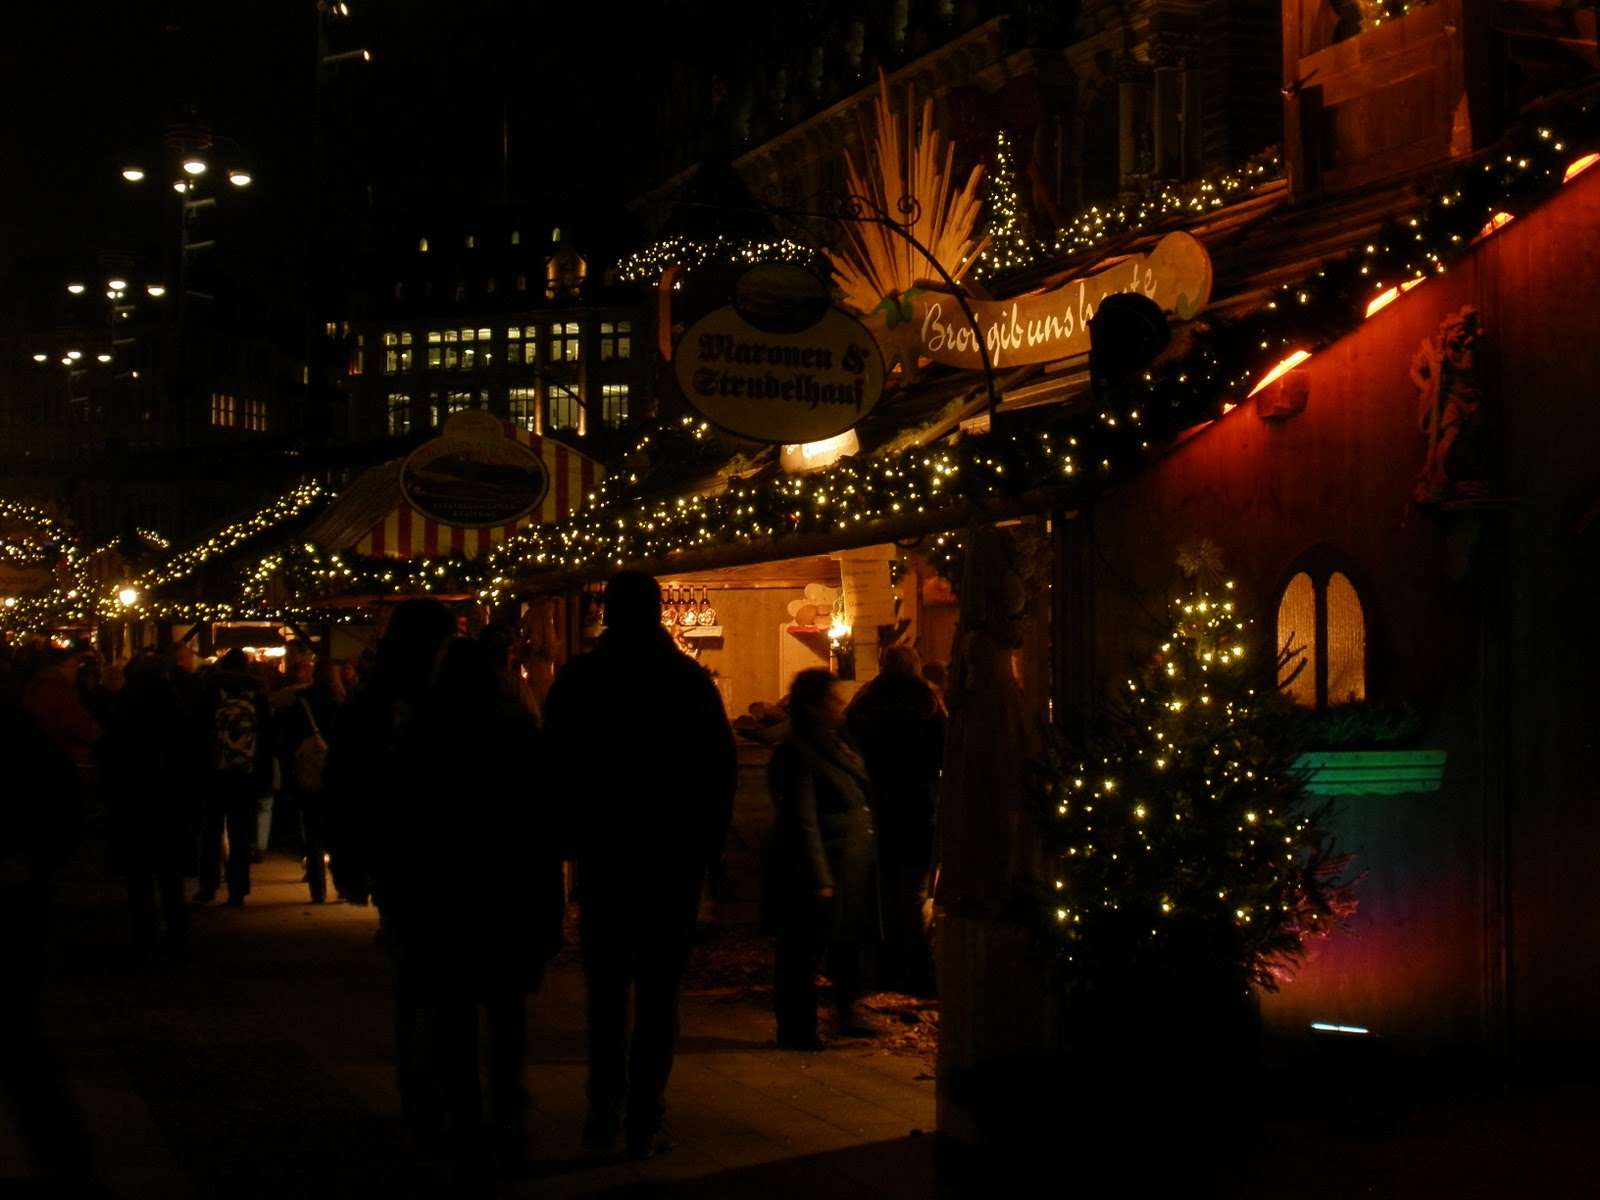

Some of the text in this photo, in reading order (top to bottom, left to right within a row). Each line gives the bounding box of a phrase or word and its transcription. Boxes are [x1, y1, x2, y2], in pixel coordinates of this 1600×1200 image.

[698, 332, 870, 374] Maronen &
[987, 302, 1023, 367] gib
[1027, 306, 1074, 346] uns
